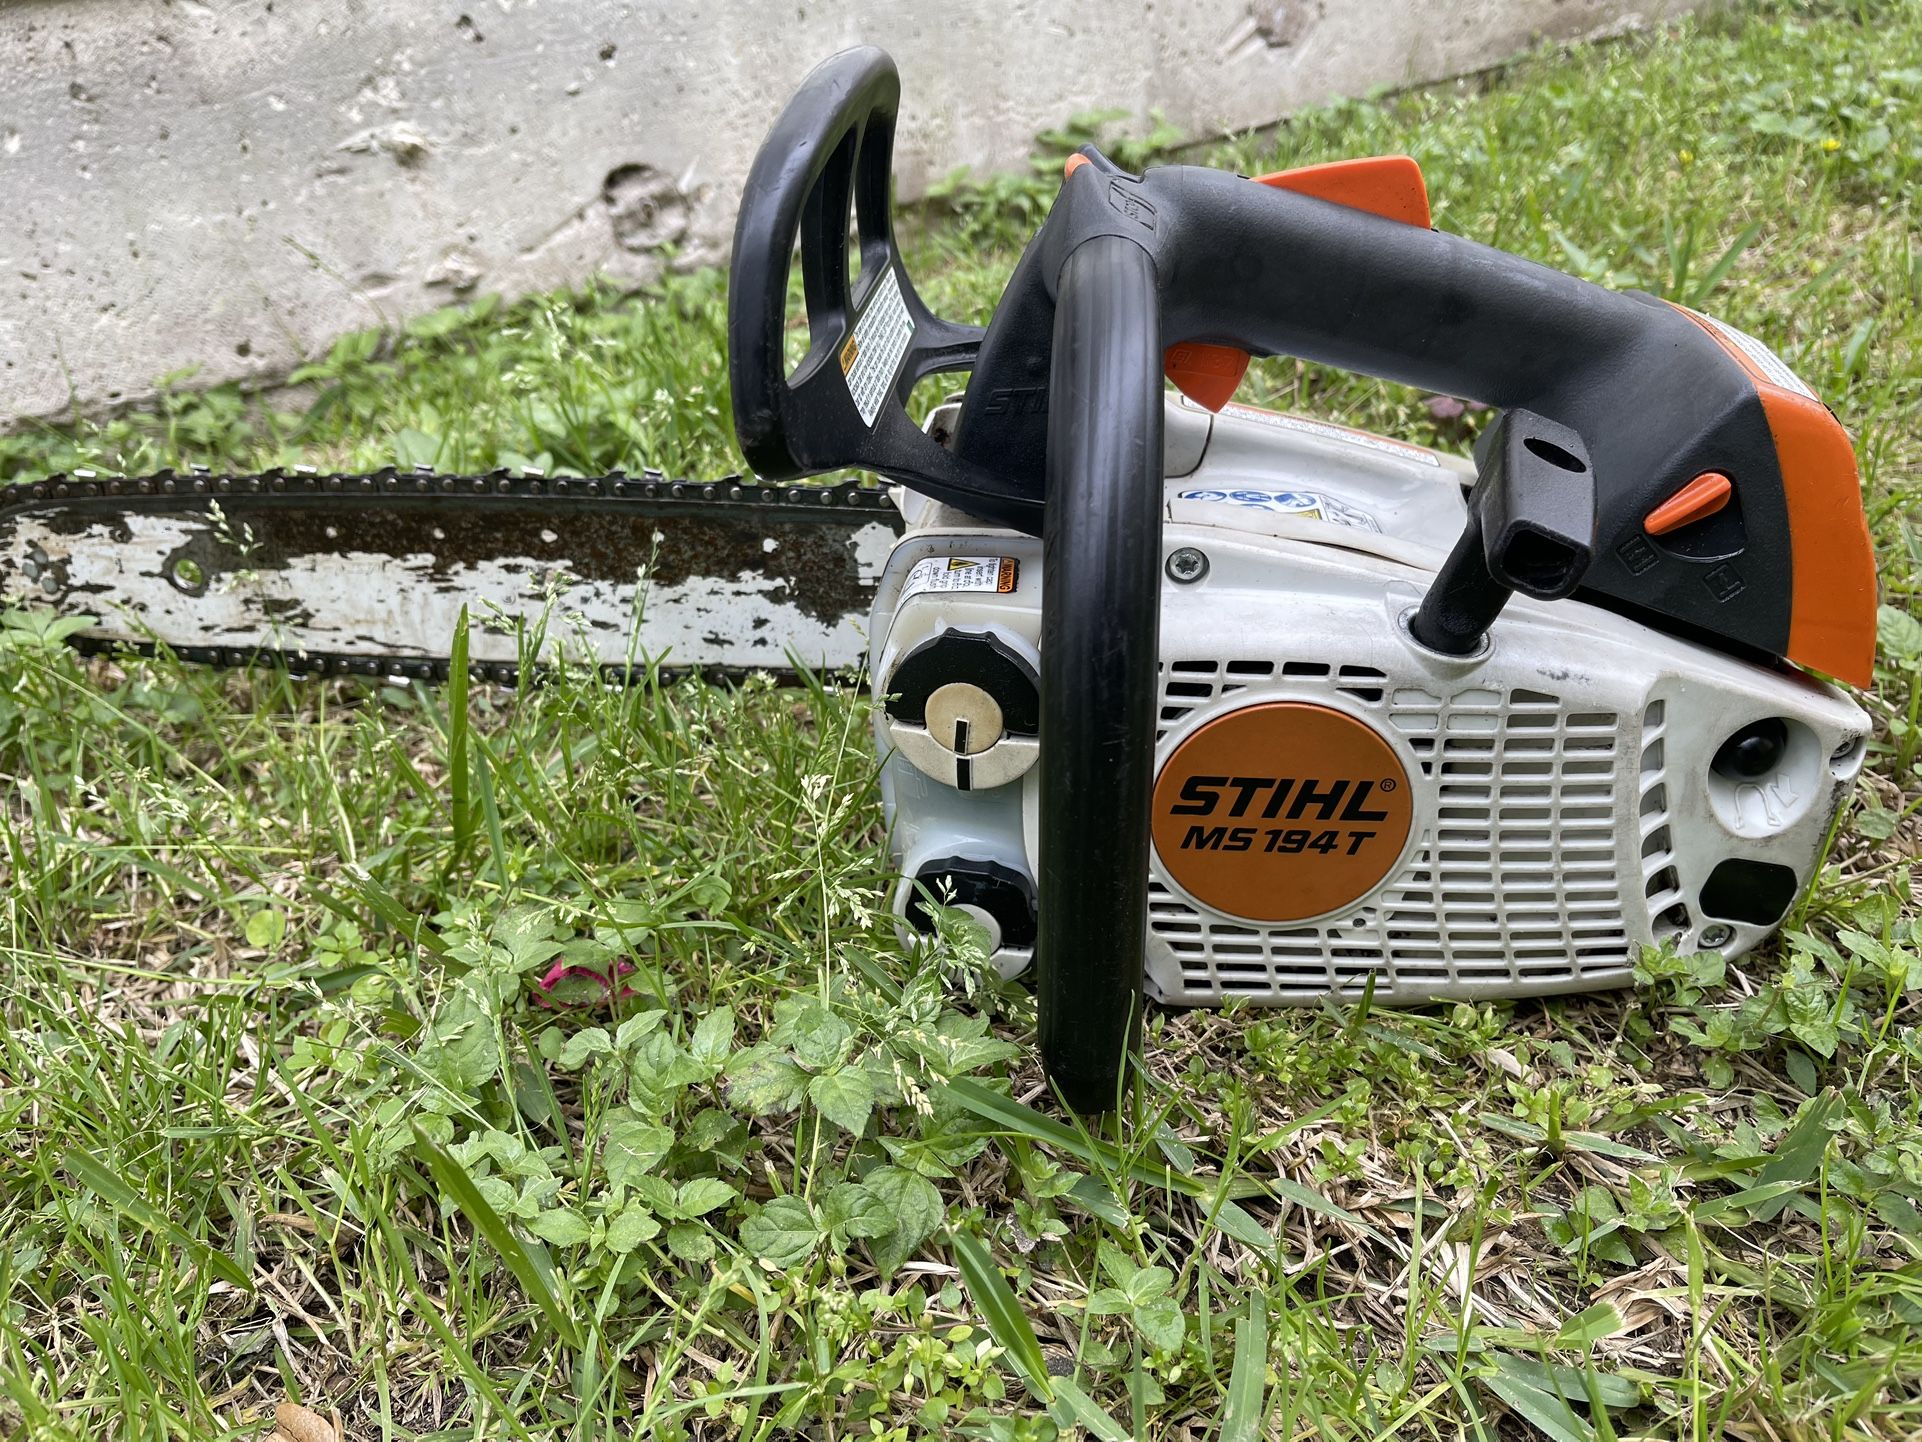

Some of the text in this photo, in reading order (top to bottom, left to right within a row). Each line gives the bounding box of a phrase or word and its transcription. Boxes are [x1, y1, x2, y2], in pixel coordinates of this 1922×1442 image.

[984, 387, 1049, 415] STI
[1000, 563, 1013, 589] WARNING
[1179, 825, 1377, 856] MS 194 T
